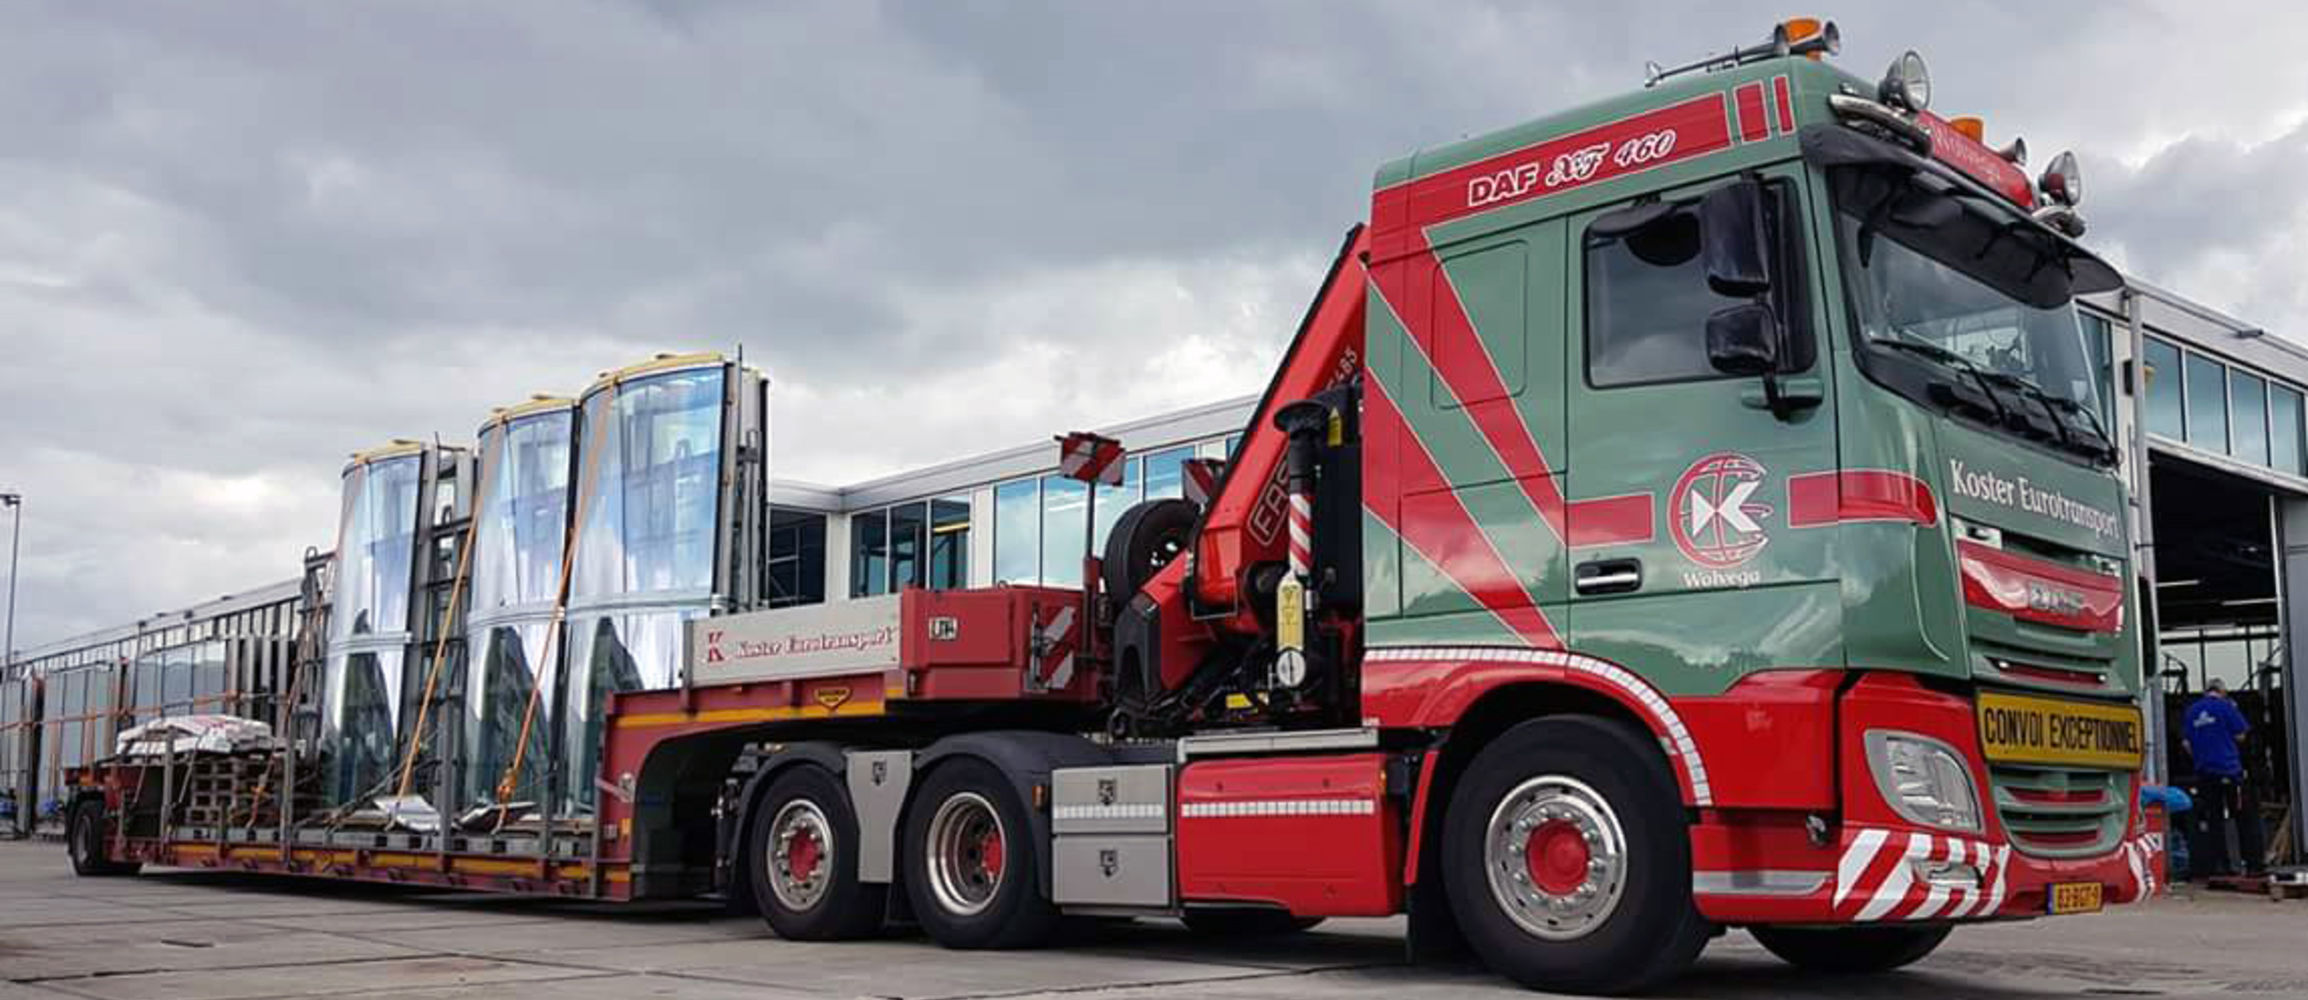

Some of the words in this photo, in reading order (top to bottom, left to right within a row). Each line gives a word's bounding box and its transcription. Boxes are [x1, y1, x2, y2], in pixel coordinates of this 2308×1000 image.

[1468, 162, 1540, 207] DAF
[1614, 129, 1677, 167] 460
[1950, 458, 2015, 506] Koster
[2017, 477, 2120, 540] Eurotransport
[1683, 569, 1760, 588] Wolvega
[1984, 707, 2045, 747] CONVOI
[2050, 713, 2139, 754] EXCEPTIONNEL
